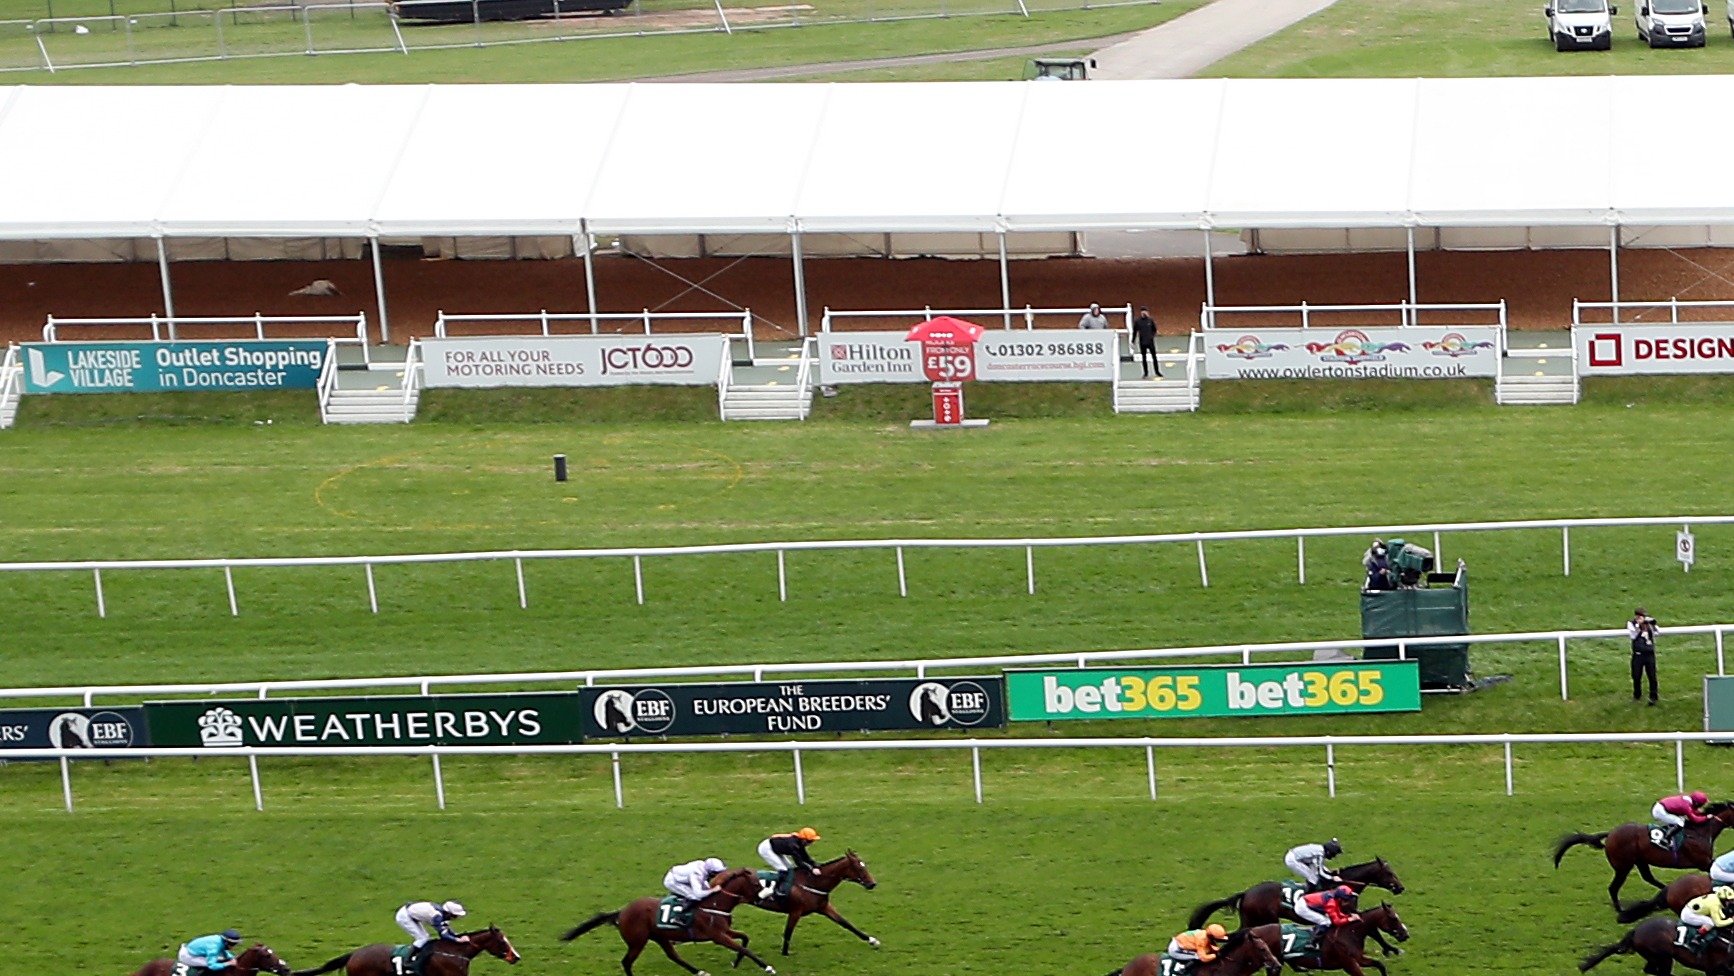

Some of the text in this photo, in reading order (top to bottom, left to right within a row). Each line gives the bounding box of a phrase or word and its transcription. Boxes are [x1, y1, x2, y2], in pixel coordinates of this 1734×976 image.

[445, 350, 551, 363] FOR ALL YOUR
[848, 344, 912, 361] Hilton
[998, 343, 1104, 356] 01302 986888
[68, 350, 141, 368] LAKESIDE
[156, 347, 322, 369] Outlet Shopping
[601, 343, 693, 375] JCT600
[446, 362, 585, 376] MOTORING NEEDS
[832, 361, 913, 374] Garden Inn
[927, 355, 973, 378] £59
[1238, 363, 1466, 378] www.owlertonstadium.co.uk
[70, 369, 134, 387] VILLAGE
[159, 368, 287, 386] in Doncaster
[779, 685, 804, 696] THE
[1044, 670, 1384, 713] bet365 bet365
[636, 700, 670, 716] EBF
[694, 698, 793, 714] EUROPEAN
[951, 693, 984, 708] EBF
[92, 723, 127, 739] EBF
[249, 709, 541, 741] WEATHERBYS
[767, 715, 822, 731] FUND
[1282, 933, 1296, 952] 7
